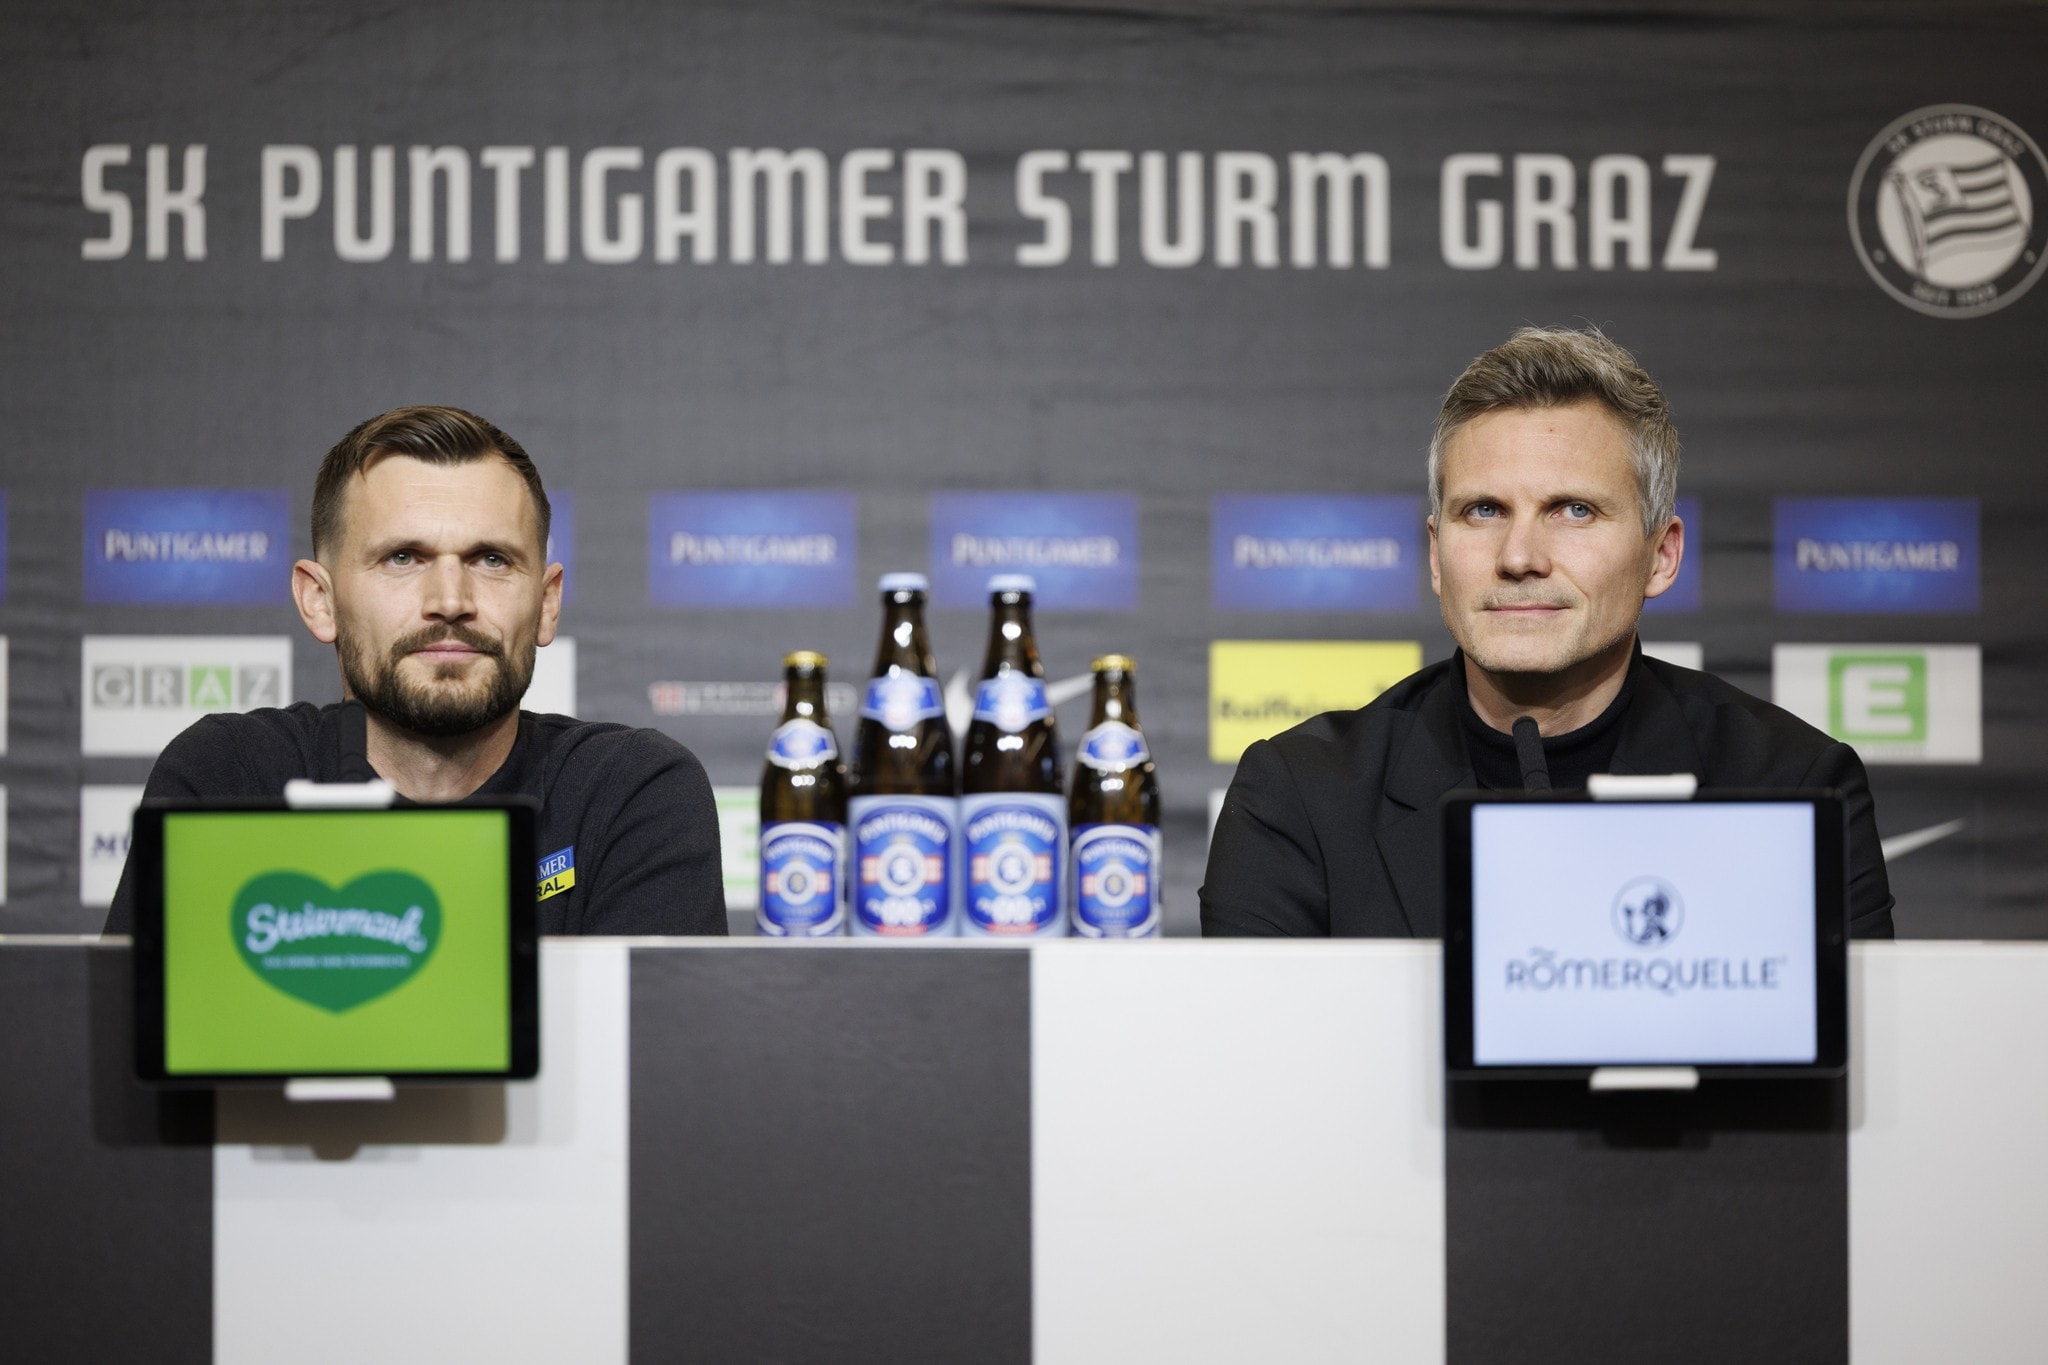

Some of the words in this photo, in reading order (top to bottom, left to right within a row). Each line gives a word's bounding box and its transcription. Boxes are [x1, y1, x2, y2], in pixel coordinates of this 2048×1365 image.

[82, 146, 207, 259] SK
[261, 146, 970, 266] PUNTIGAMER
[1015, 150, 1390, 268] STURM
[1440, 154, 1717, 269] GRAZ
[104, 529, 268, 563] PUNTIGAMER
[670, 531, 838, 566] PUNTIGAMER
[951, 532, 1120, 567] PUNTIGAMER
[1233, 534, 1400, 569] PUNTIGAMER
[1796, 537, 1959, 572] PUNTIGAMER
[92, 664, 282, 710] GRAZ
[536, 855, 567, 880] MER
[246, 902, 428, 954] Steiermark
